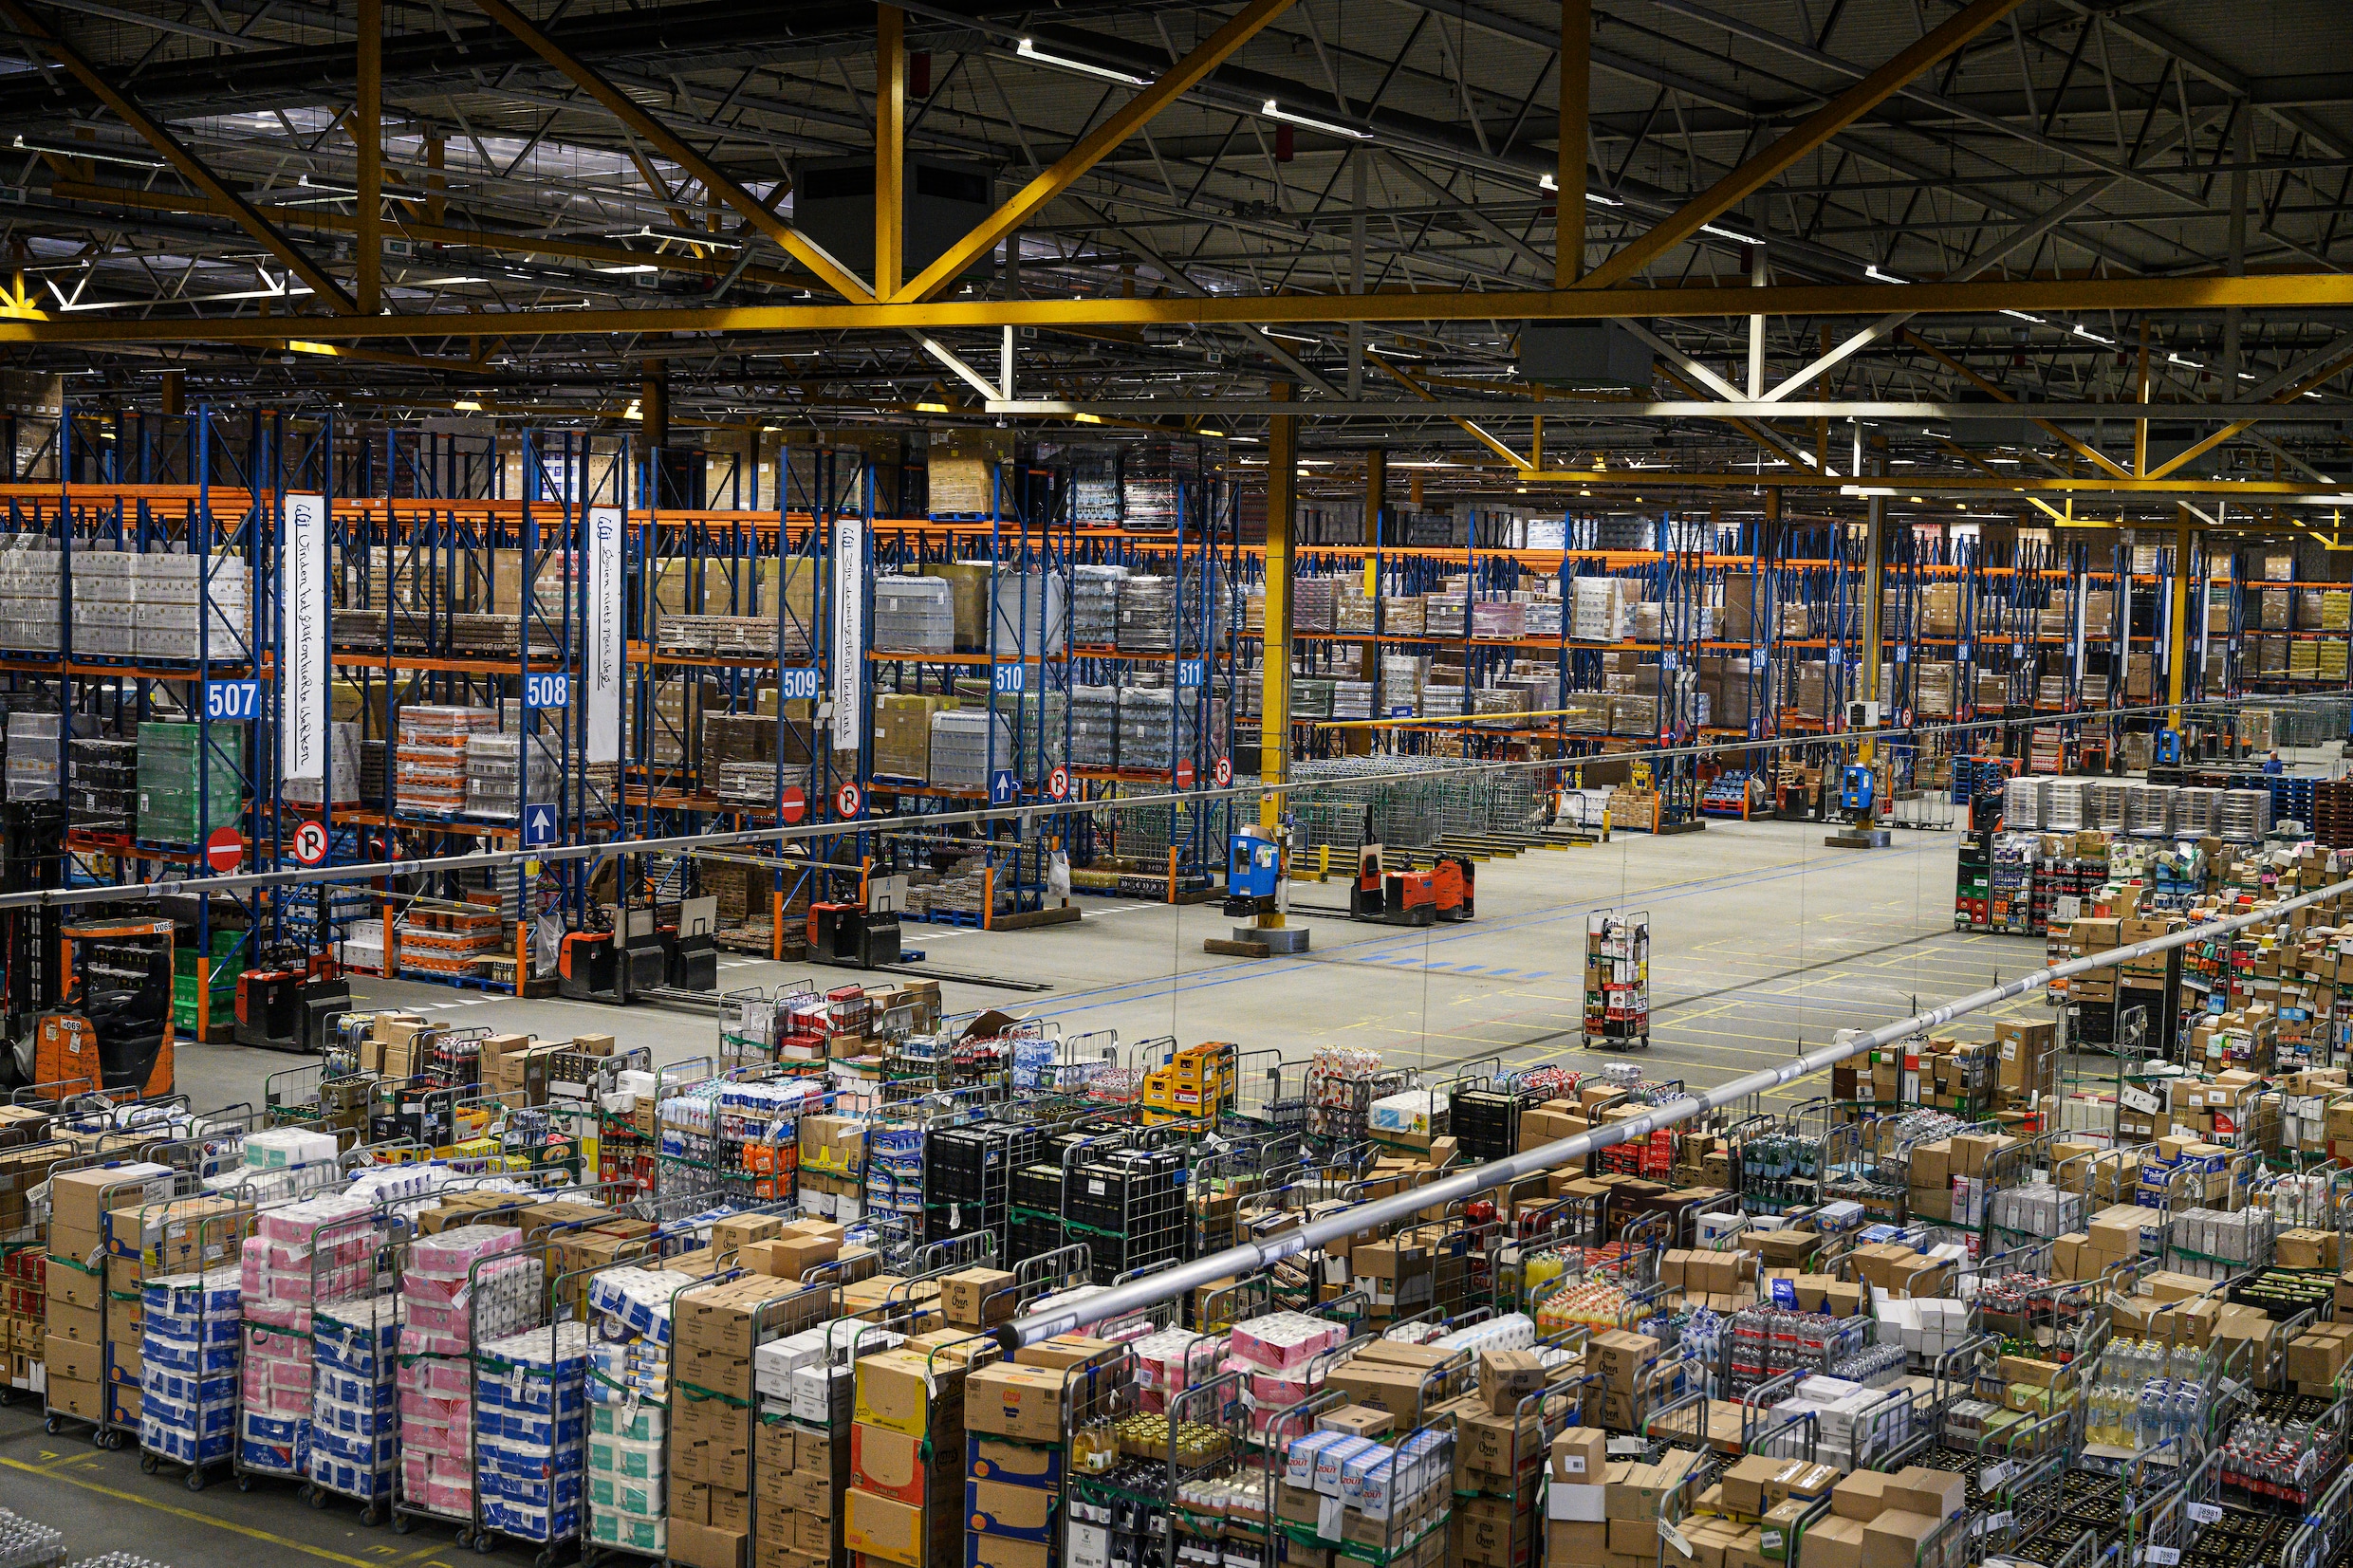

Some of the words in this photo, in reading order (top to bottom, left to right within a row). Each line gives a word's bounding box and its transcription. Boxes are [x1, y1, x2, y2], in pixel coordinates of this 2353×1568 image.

[299, 588, 311, 613] het
[1663, 652, 1676, 669] 515
[1753, 650, 1765, 666] 516
[1829, 649, 1841, 663] 517
[1898, 647, 1906, 662] 518
[997, 666, 1023, 690] 510
[1180, 662, 1200, 684] 511
[528, 676, 566, 706] 508
[785, 671, 816, 696] 509
[210, 684, 256, 716] 507
[300, 690, 310, 703] te
[1055, 775, 1064, 793] P
[845, 790, 854, 811] P
[306, 831, 319, 856] P
[155, 923, 173, 932] V069
[63, 1020, 81, 1030] 069
[1317, 1466, 1338, 1474] ZOUT
[1341, 1477, 1362, 1485] ZOUT
[1362, 1490, 1382, 1499] ZOUT
[2201, 1508, 2219, 1518] 8981
[2163, 1549, 2177, 1559] 8981
